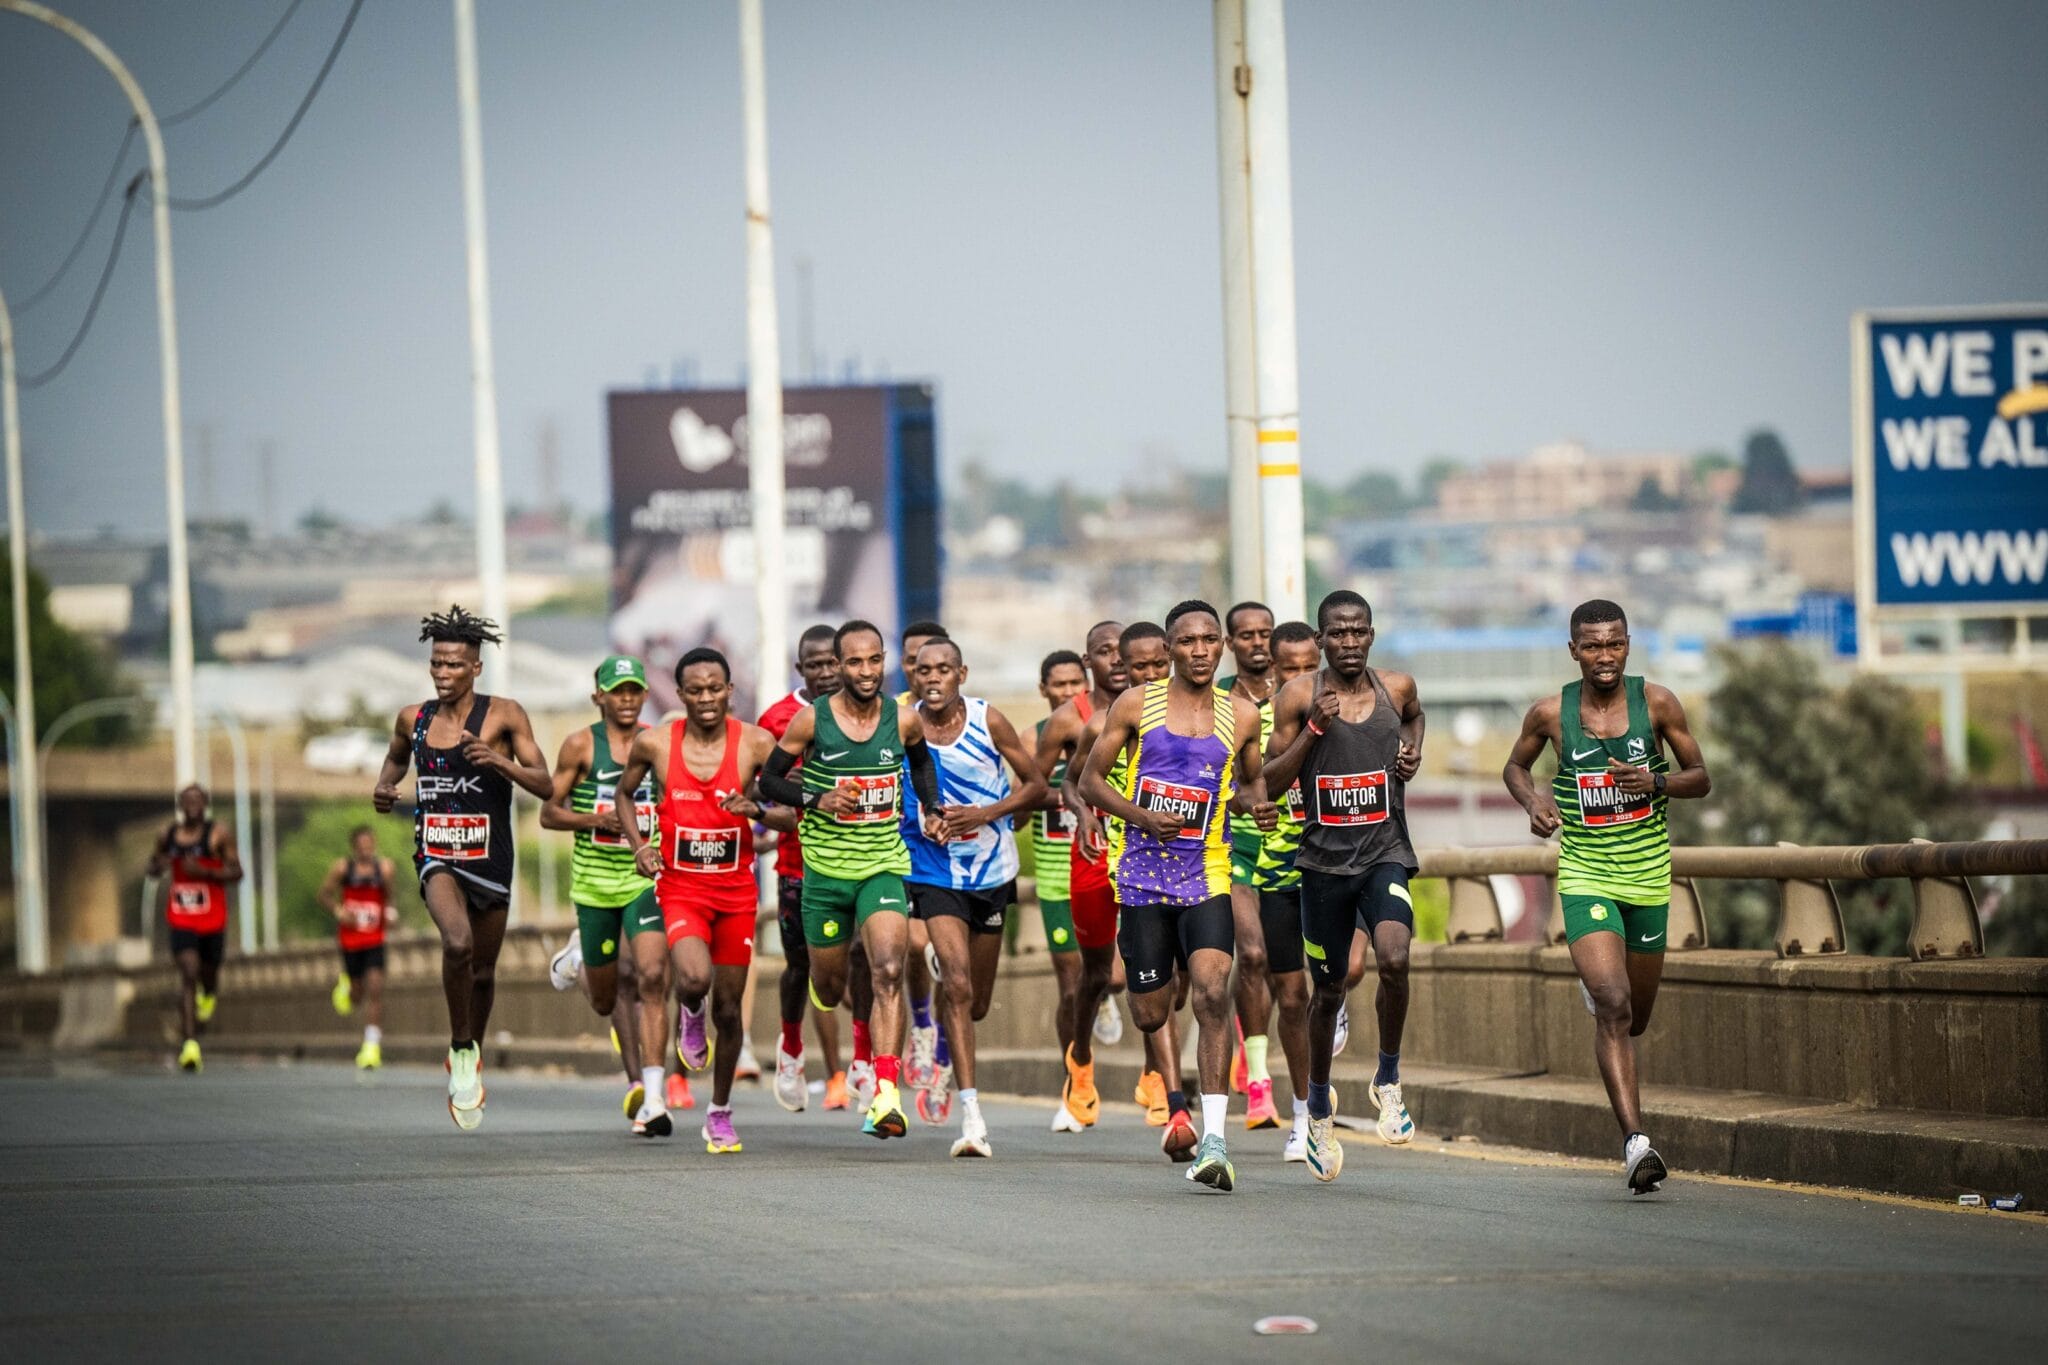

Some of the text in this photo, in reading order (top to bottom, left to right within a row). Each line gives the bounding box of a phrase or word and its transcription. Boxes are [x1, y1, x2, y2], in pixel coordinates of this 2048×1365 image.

[1880, 330, 1996, 398] WE
[1882, 415, 2048, 470] WE AL
[1891, 529, 2048, 587] WWW
[418, 775, 483, 803] PEAK
[1329, 786, 1377, 807] VICTOR
[1147, 794, 1199, 820] JOSEPH
[1348, 806, 1360, 815] 46
[1613, 804, 1624, 814] 15
[427, 826, 485, 844] BONGELANI
[689, 841, 726, 857] CHRIS
